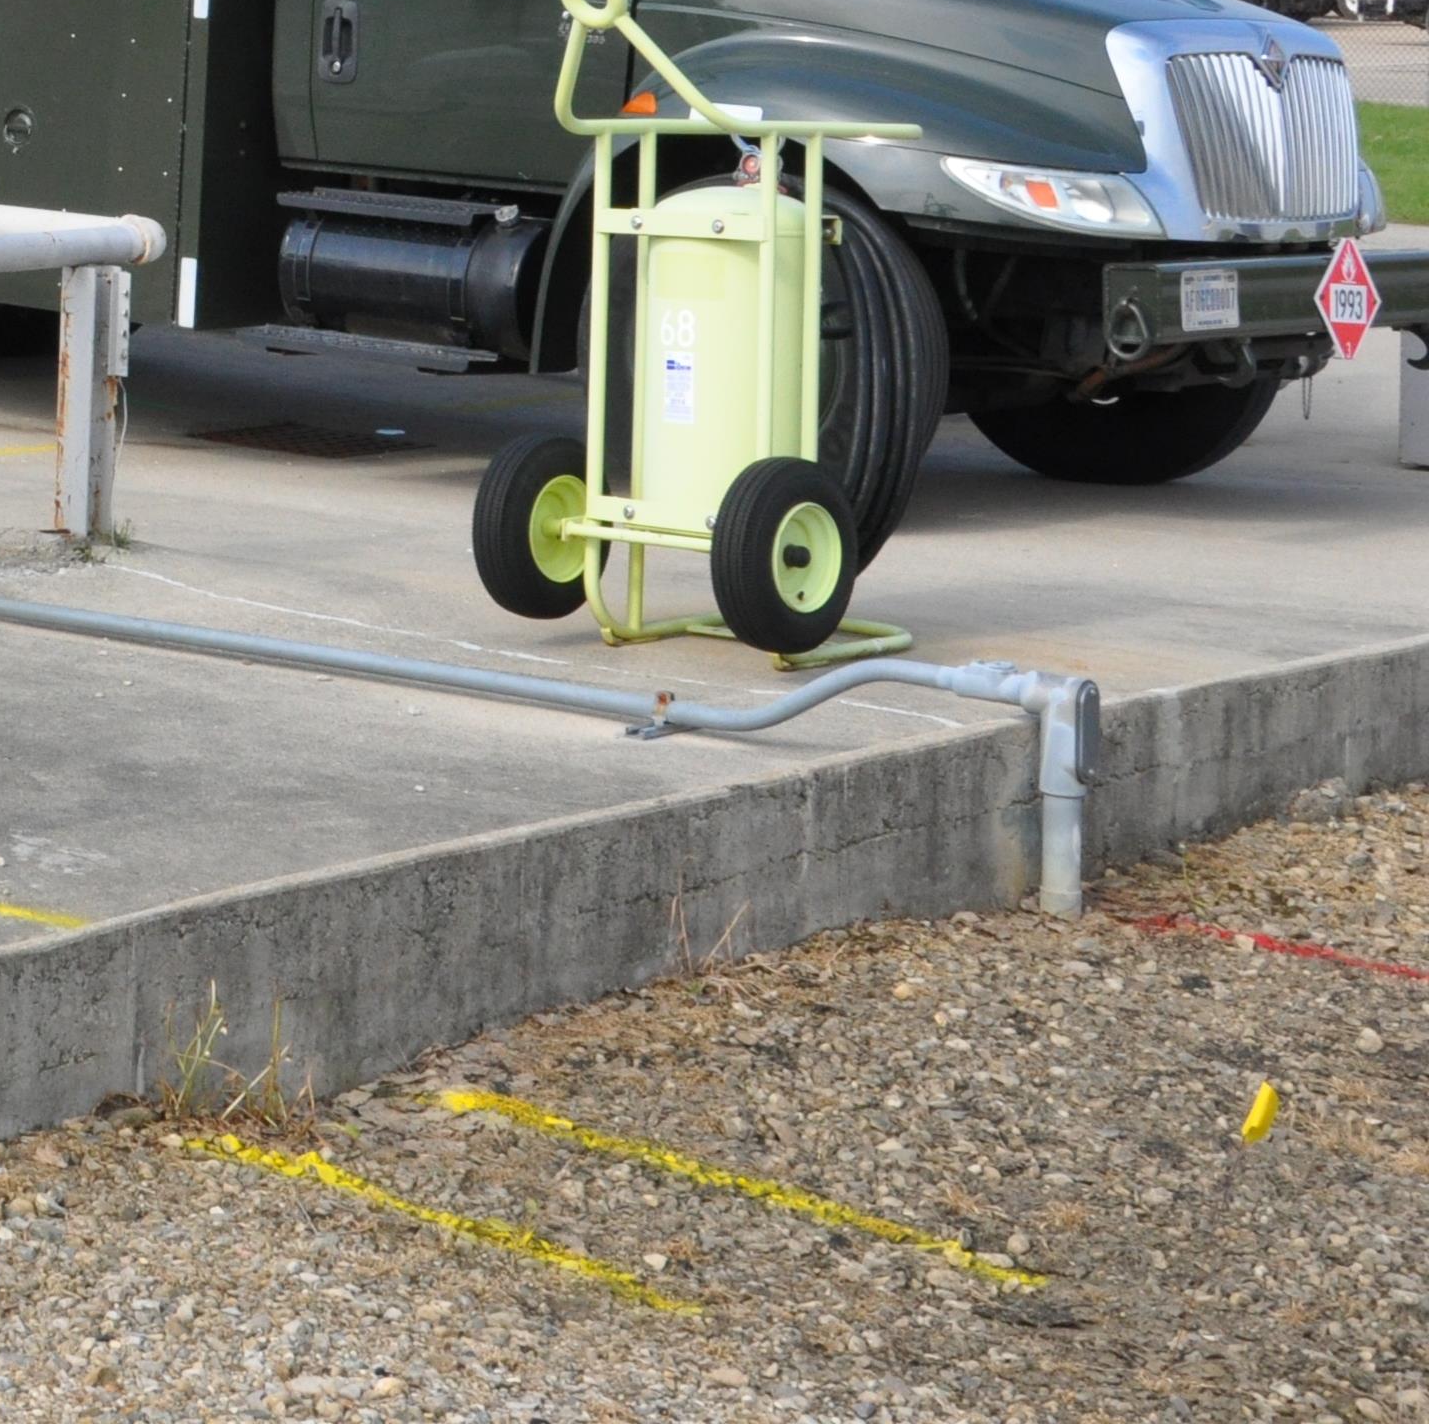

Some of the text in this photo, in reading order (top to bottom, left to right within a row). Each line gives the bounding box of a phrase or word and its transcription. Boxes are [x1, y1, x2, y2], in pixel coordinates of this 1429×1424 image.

[1333, 288, 1363, 320] 1993
[660, 308, 697, 349] 68
[1344, 341, 1352, 359] 3
